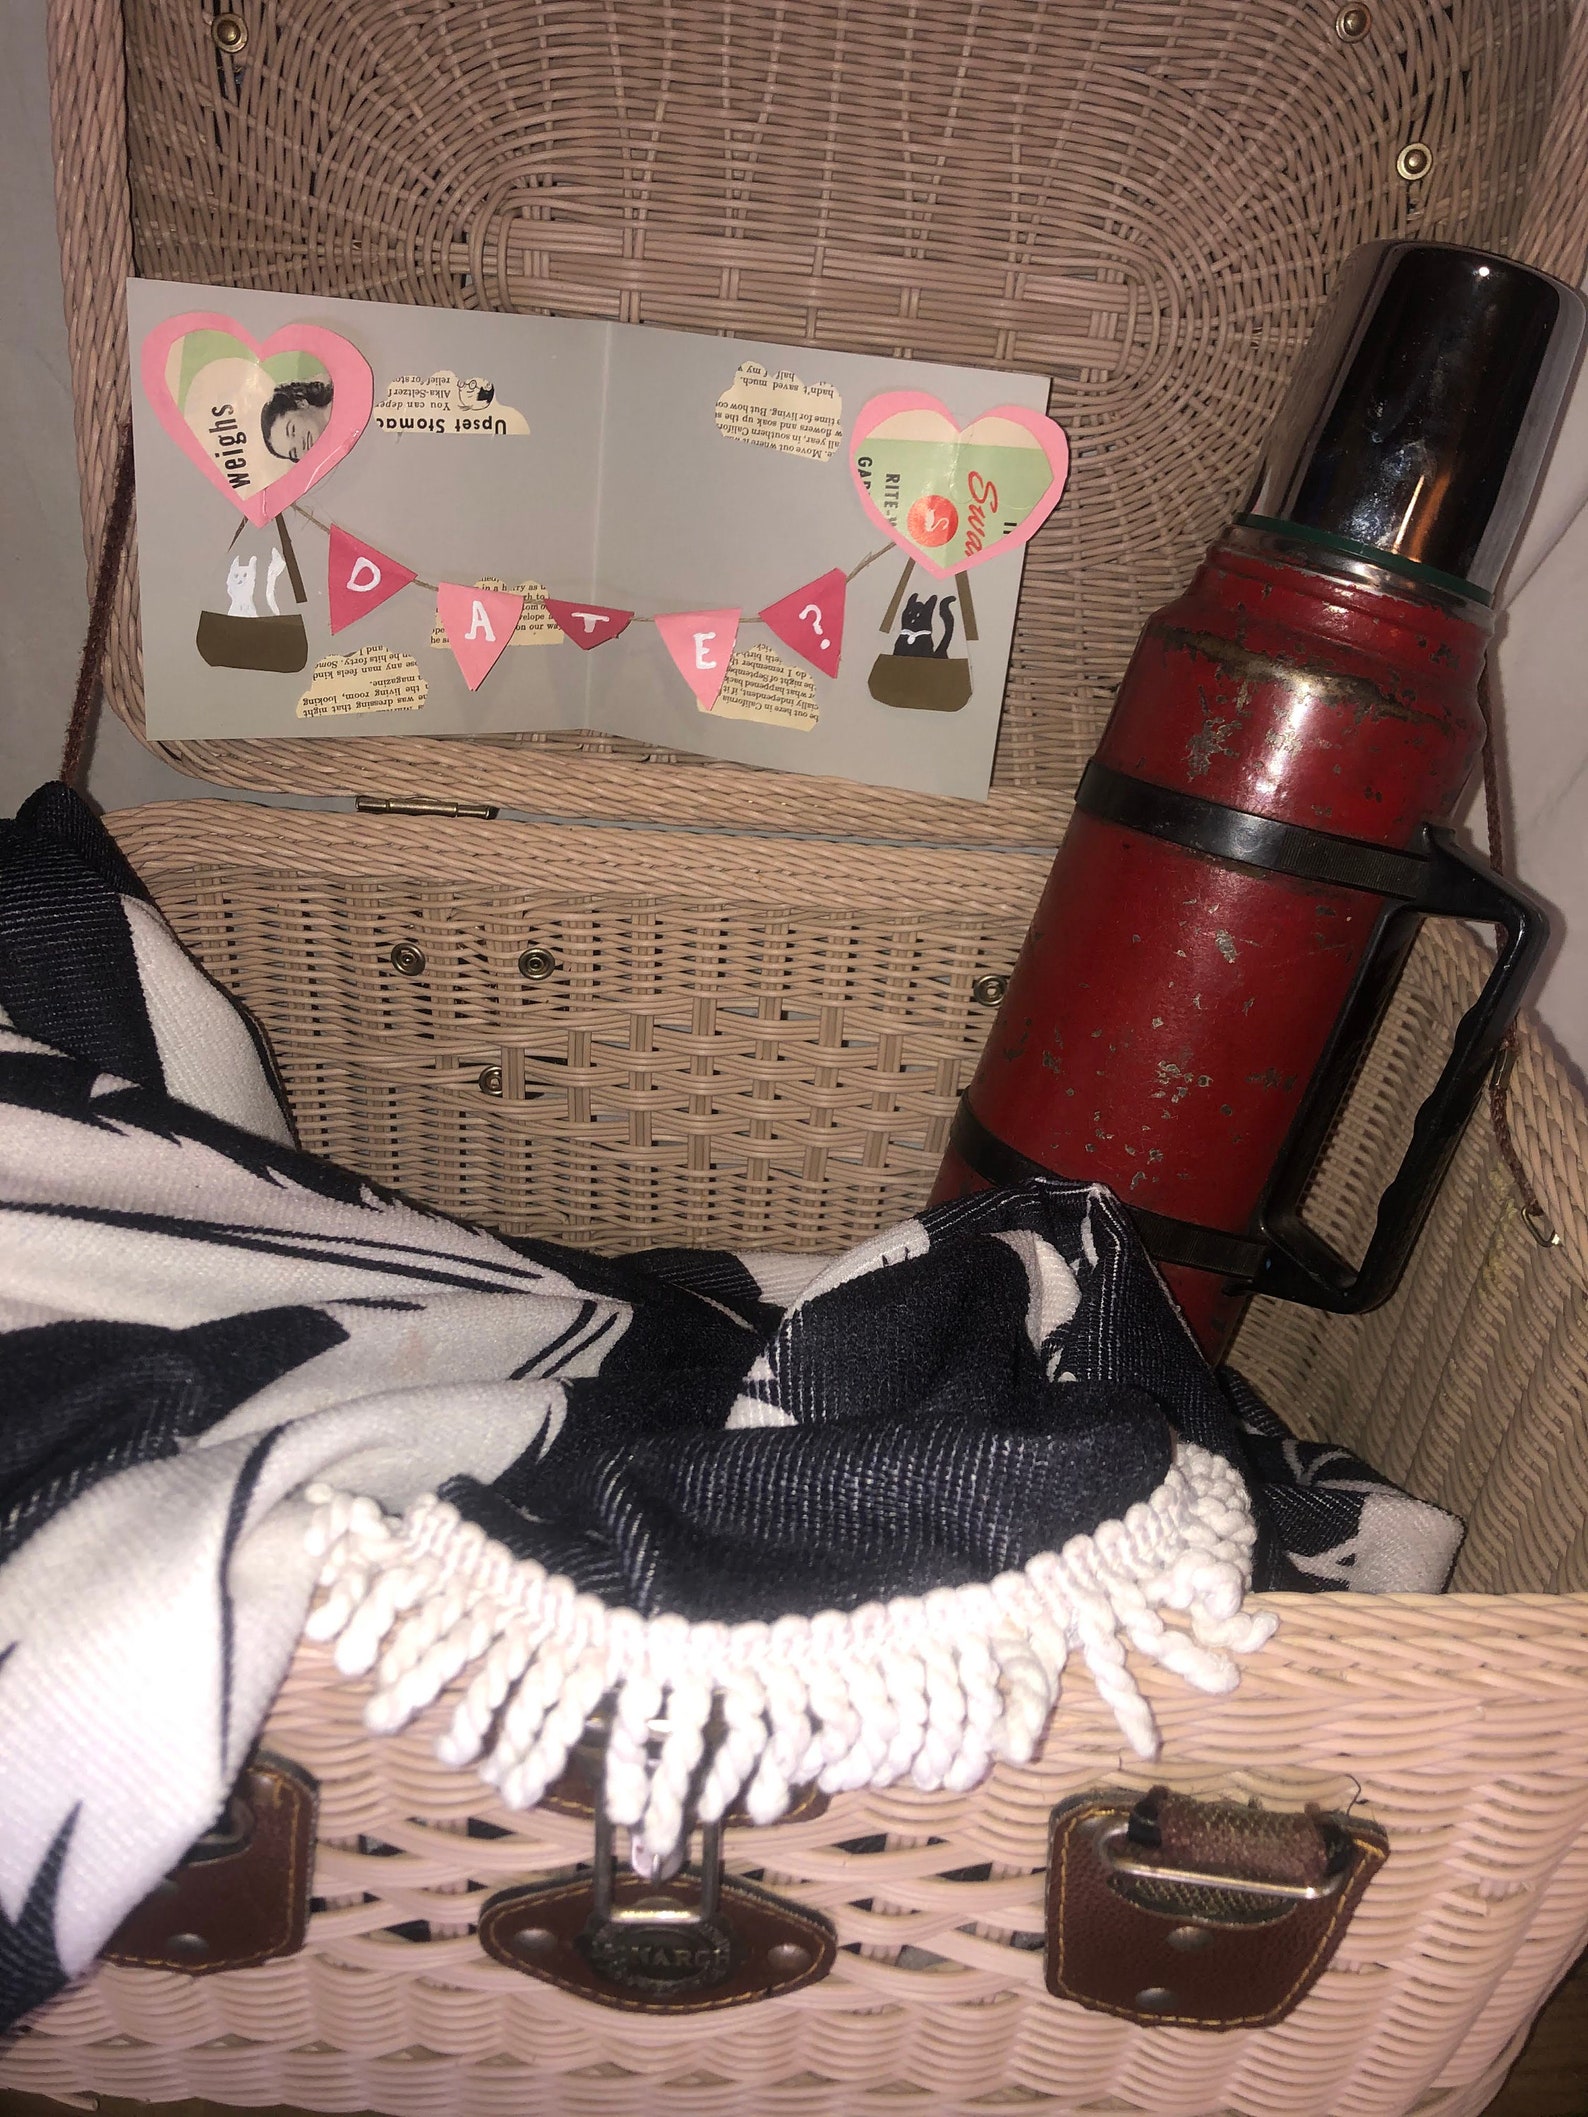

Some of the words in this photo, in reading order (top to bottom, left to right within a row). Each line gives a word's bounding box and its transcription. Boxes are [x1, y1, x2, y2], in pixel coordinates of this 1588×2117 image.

[746, 366, 761, 375] my
[426, 377, 450, 385] relief
[776, 371, 795, 382] half
[740, 377, 767, 388] much.
[772, 382, 799, 393] saved
[394, 389, 450, 398] Alka-Seltzer
[803, 386, 834, 399] hadn't
[407, 401, 425, 409] can
[430, 402, 450, 411] You
[729, 403, 748, 413] how
[750, 406, 766, 416] But
[770, 408, 797, 420] living.
[725, 413, 739, 422] the
[742, 415, 753, 424] up
[799, 414, 812, 423] for
[814, 416, 835, 425] time
[455, 416, 507, 434] Upset
[756, 418, 777, 428] soak
[751, 428, 790, 440] southern
[800, 425, 832, 437] flowers
[792, 435, 801, 443] in
[804, 435, 826, 446] year,
[829, 440, 840, 448] all
[208, 404, 251, 489] weighs
[796, 447, 822, 458] Move
[366, 645, 383, 654] and
[340, 657, 367, 667] forty.
[369, 655, 386, 664] hits
[389, 653, 400, 662] he
[361, 665, 381, 674] man
[385, 662, 402, 670] any
[742, 660, 784, 674] remember
[312, 671, 333, 681] kind
[336, 668, 358, 676] feels
[796, 671, 806, 679] do
[369, 675, 415, 686] magazine.
[724, 676, 743, 687] back
[780, 677, 802, 688] night
[374, 687, 401, 697] living
[723, 686, 730, 695] it
[731, 687, 738, 696] if
[745, 680, 785, 695] happened
[342, 692, 370, 701] room,
[740, 688, 794, 706] independent,
[786, 688, 806, 698] what
[302, 695, 337, 706] looking
[355, 698, 393, 709] dressing
[722, 696, 762, 710] California
[796, 699, 818, 711] cially
[302, 706, 328, 718] night
[331, 703, 351, 713] that
[764, 704, 772, 712] in
[774, 706, 792, 716] here
[793, 710, 808, 718] out
[809, 714, 819, 722] be
